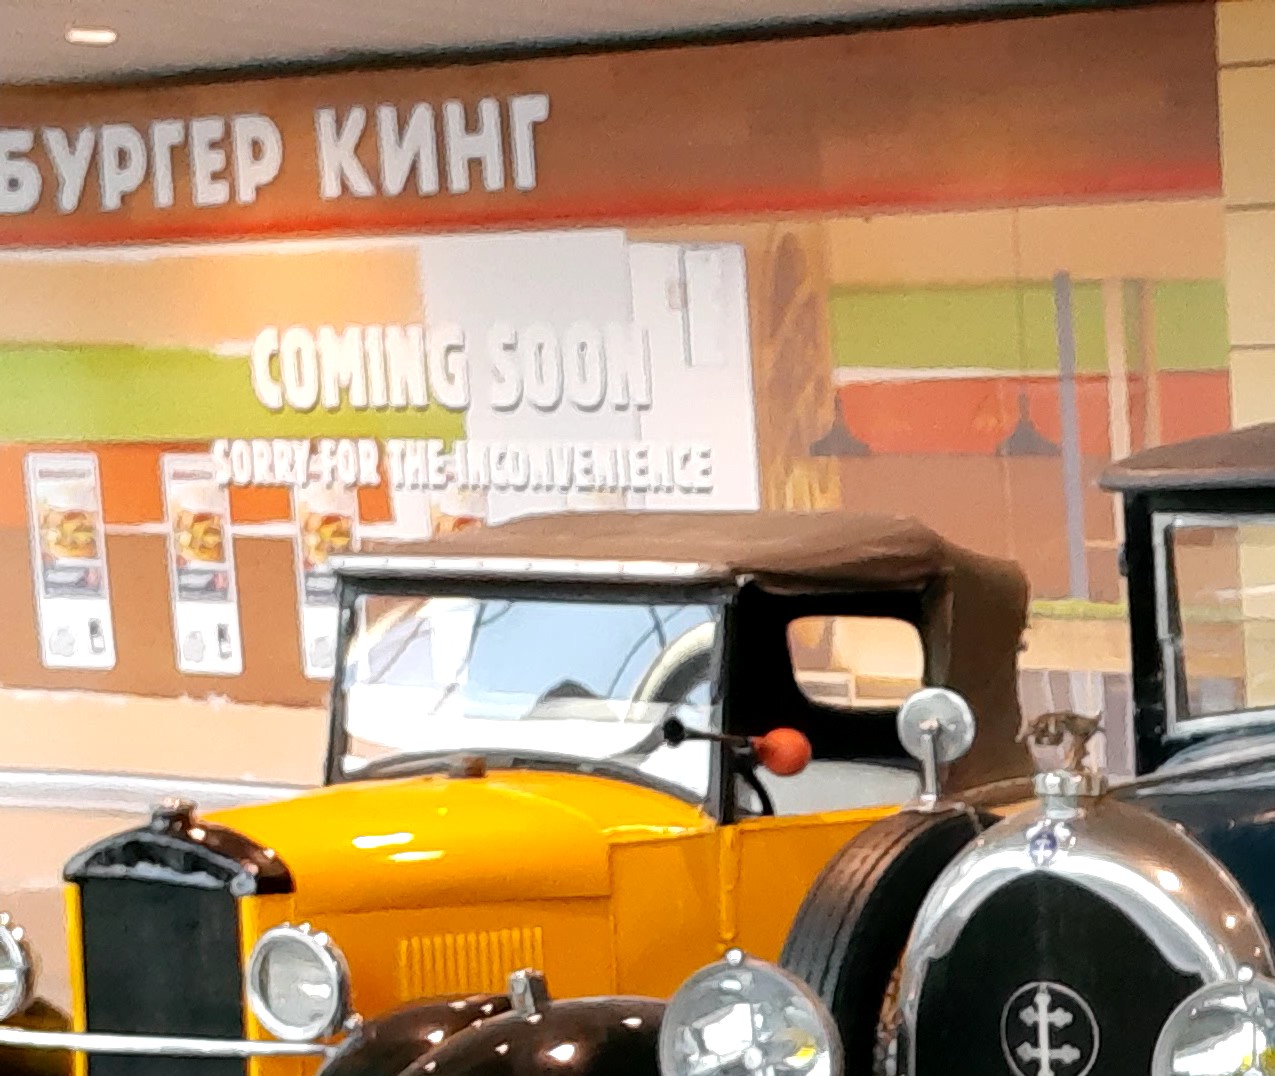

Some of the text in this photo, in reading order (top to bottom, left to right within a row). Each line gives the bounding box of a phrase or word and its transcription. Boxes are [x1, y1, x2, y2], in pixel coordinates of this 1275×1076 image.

[0, 94, 550, 213] БУРГЕР КИНГ
[251, 325, 652, 412] COMING SOON
[213, 438, 714, 494] SORRY FOR THE INCONVENIENCE
